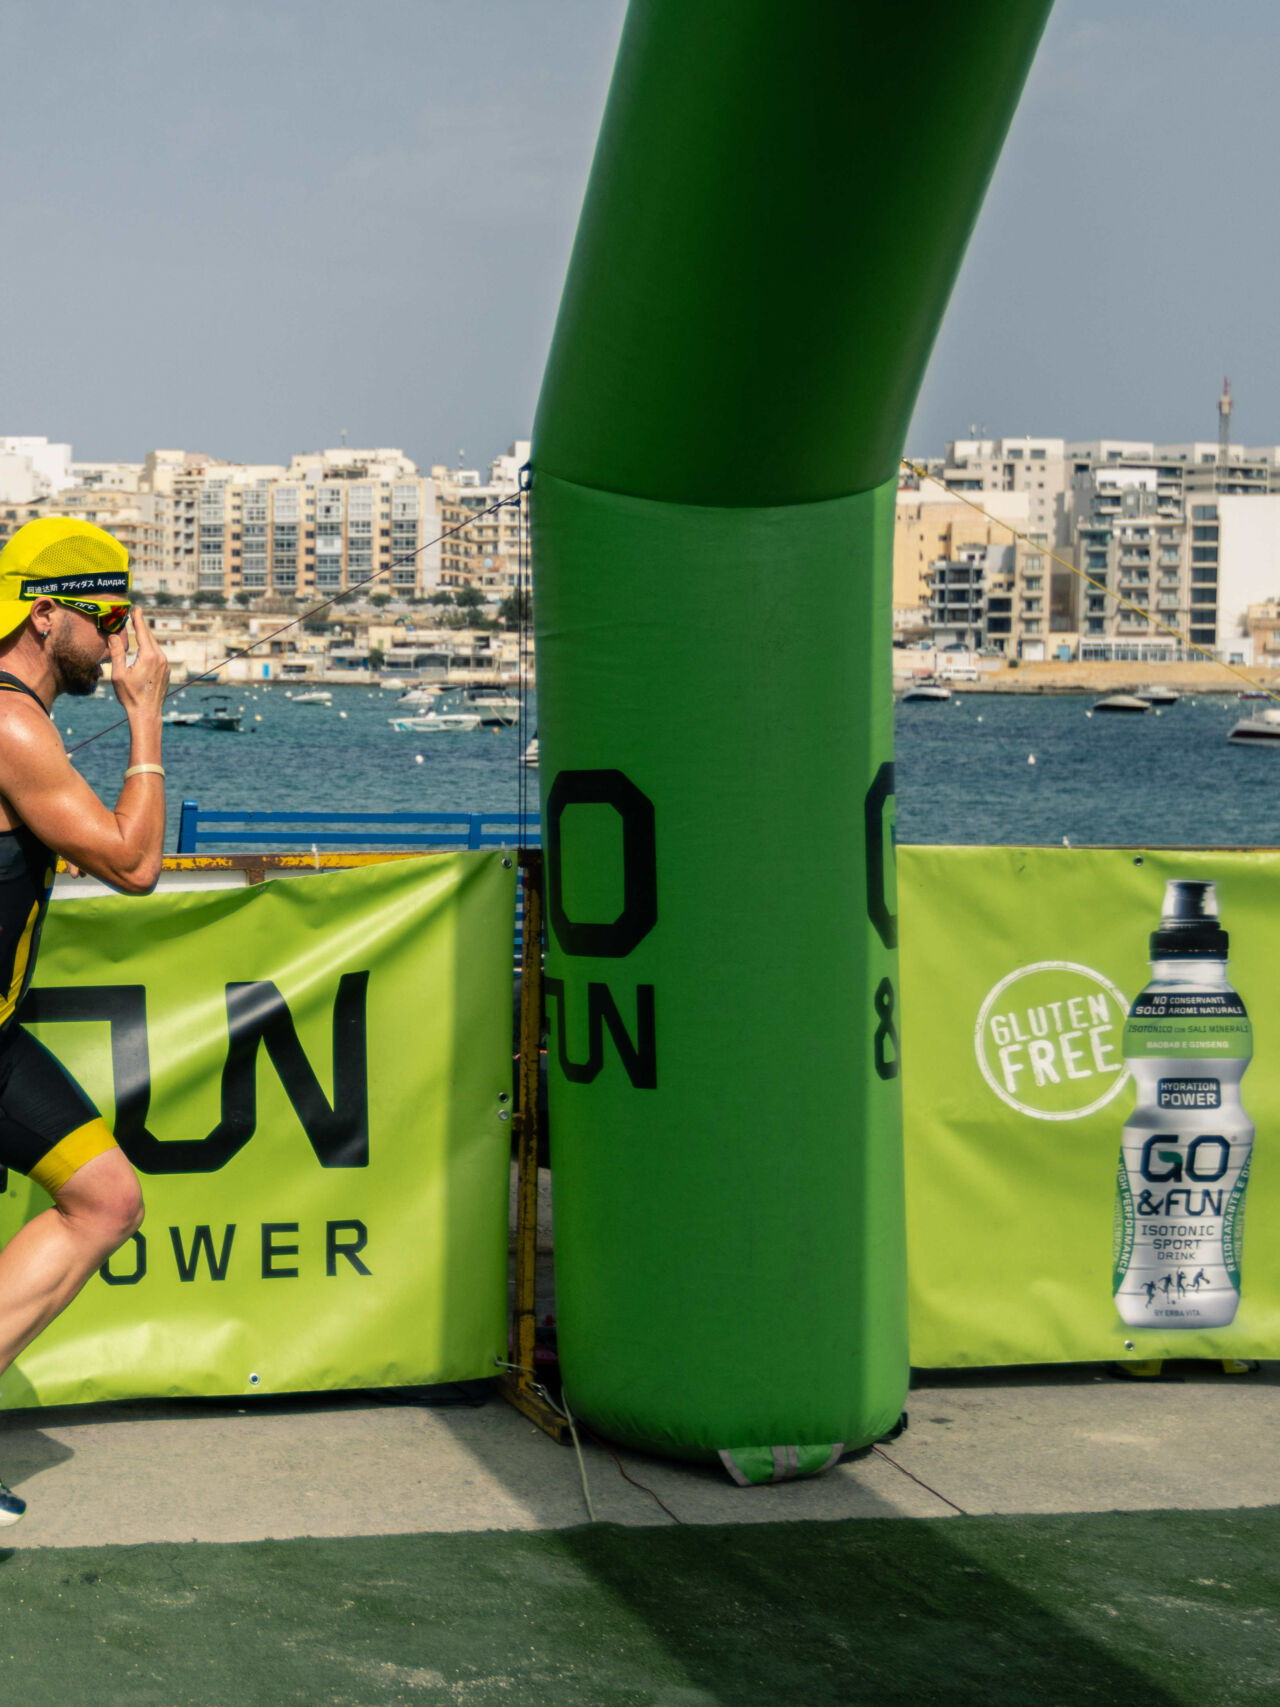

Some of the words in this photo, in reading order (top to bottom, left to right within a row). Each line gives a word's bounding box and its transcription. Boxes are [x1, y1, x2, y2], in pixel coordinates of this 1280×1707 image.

[97, 578, 126, 587] Адидас
[1152, 996, 1167, 1004] NO
[1169, 996, 1226, 1004] CONSERVANTI
[1135, 1006, 1165, 1015] SOLO
[1168, 1006, 1198, 1014] AROMI
[1200, 1006, 1242, 1014] NATURALI
[990, 993, 1110, 1046] GLUTEN
[1128, 1024, 1173, 1033] ISOTONICO
[1188, 1025, 1207, 1033] SALI
[1208, 1025, 1249, 1033] MINERALI
[1146, 1041, 1180, 1049] BAOBAB
[998, 1024, 1122, 1094] FREE
[1161, 1082, 1217, 1091] HYDRATION
[1161, 1093, 1217, 1106] POWER
[1139, 1134, 1231, 1183] GO
[1137, 1189, 1223, 1216] &FUN
[1117, 1191, 1133, 1275] PERFORMANCE
[1141, 1225, 1215, 1237] ISOTONIC
[1224, 1191, 1241, 1272] REIDRATANTE
[1153, 1239, 1202, 1250] SPORT
[100, 1219, 373, 1286] OWER
[1157, 1252, 1195, 1260] DRINK
